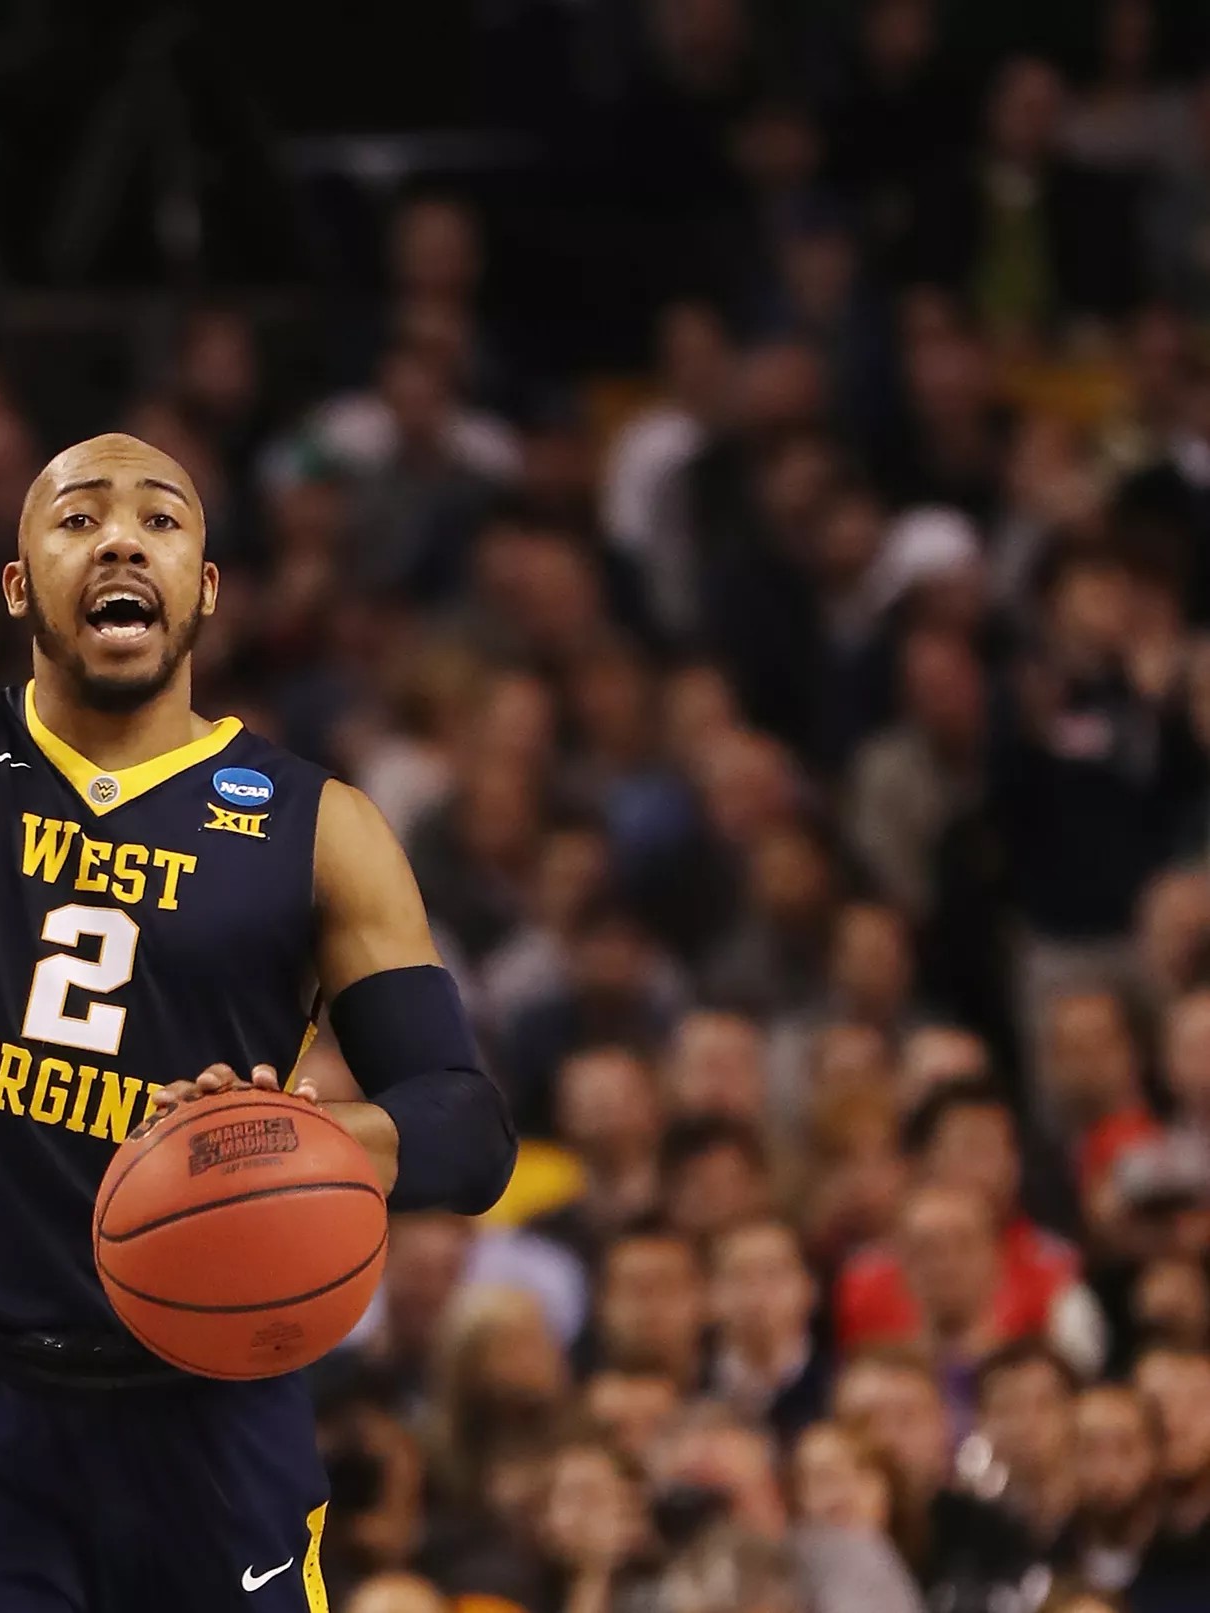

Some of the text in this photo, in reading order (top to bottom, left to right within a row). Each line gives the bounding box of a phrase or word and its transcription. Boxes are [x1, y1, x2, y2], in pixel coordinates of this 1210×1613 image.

[219, 781, 270, 799] NCAA
[203, 801, 270, 839] XII
[21, 812, 198, 911] WEST
[21, 903, 141, 1056] 2
[208, 1119, 266, 1144] MARCH
